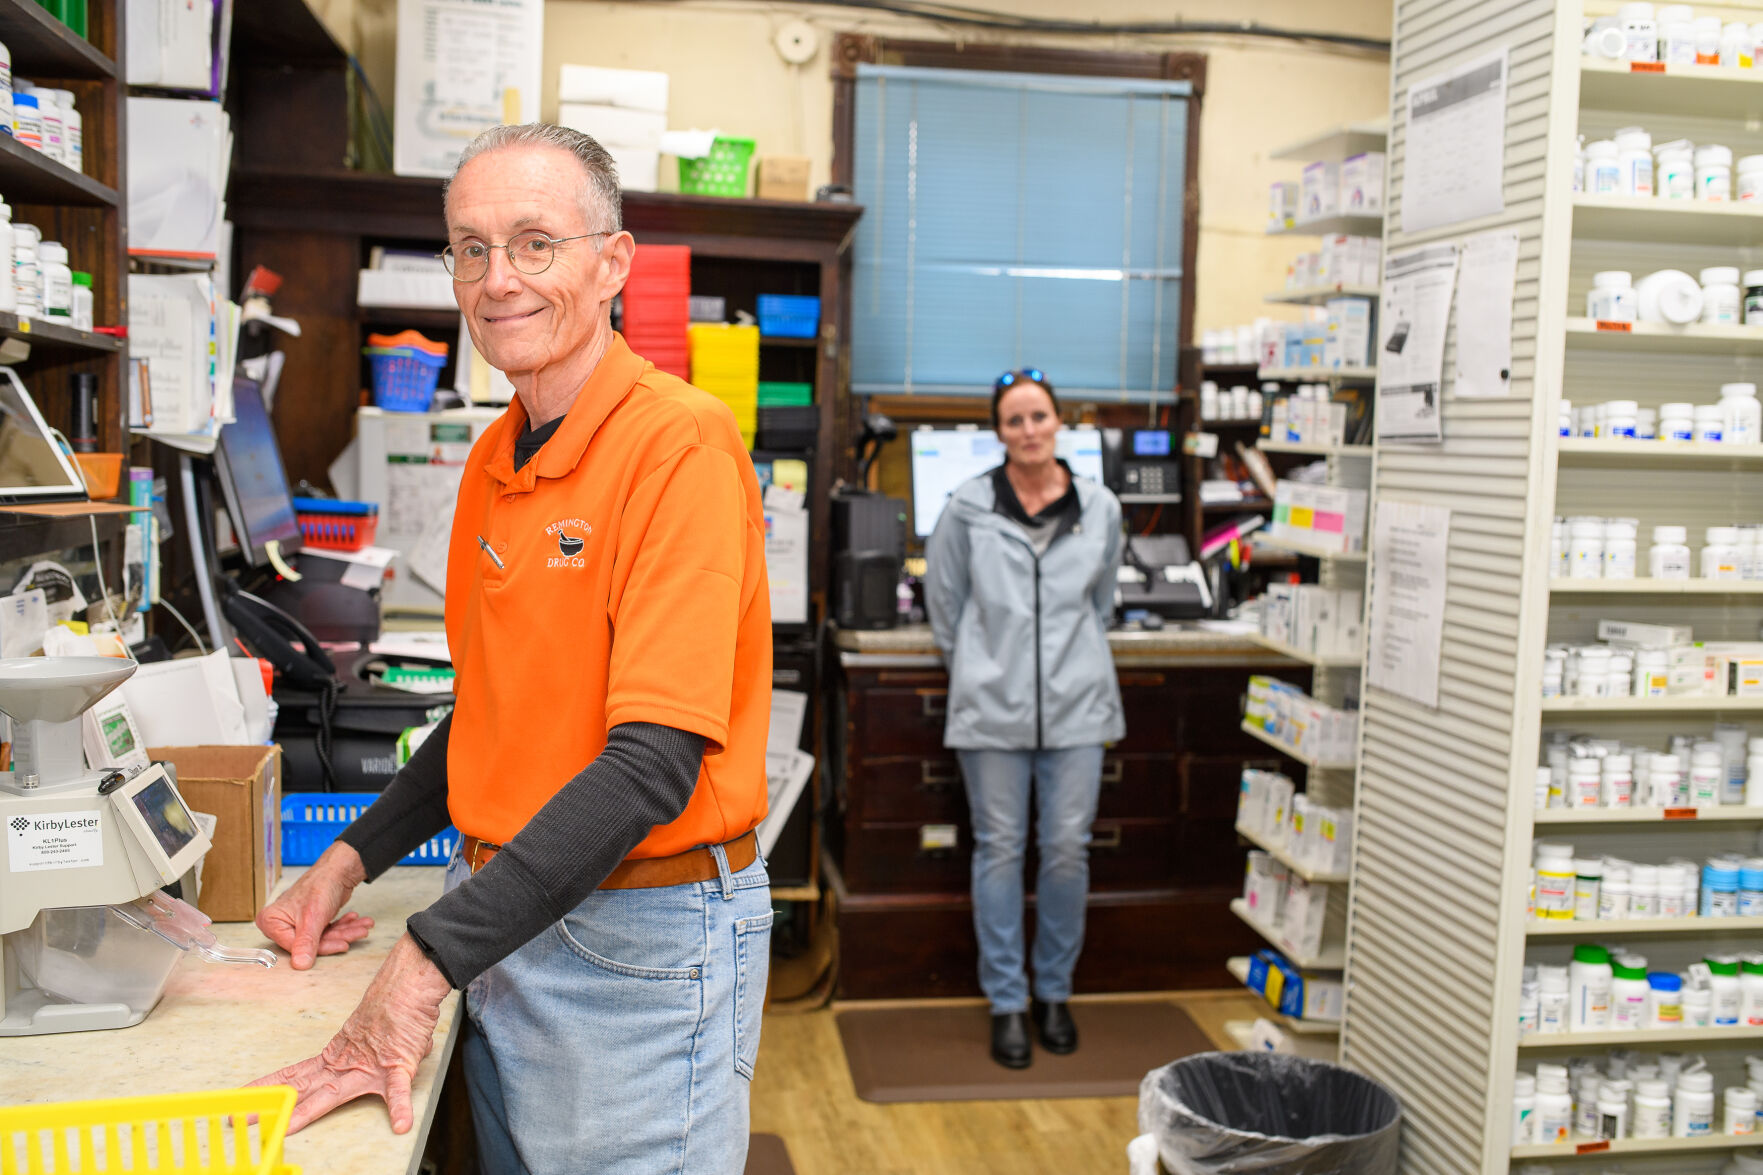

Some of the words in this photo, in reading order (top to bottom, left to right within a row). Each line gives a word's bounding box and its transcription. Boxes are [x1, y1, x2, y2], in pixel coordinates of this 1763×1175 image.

[545, 518, 592, 535] REMINGTON
[547, 557, 569, 568] DRUG
[34, 818, 99, 831] KirbyLester
